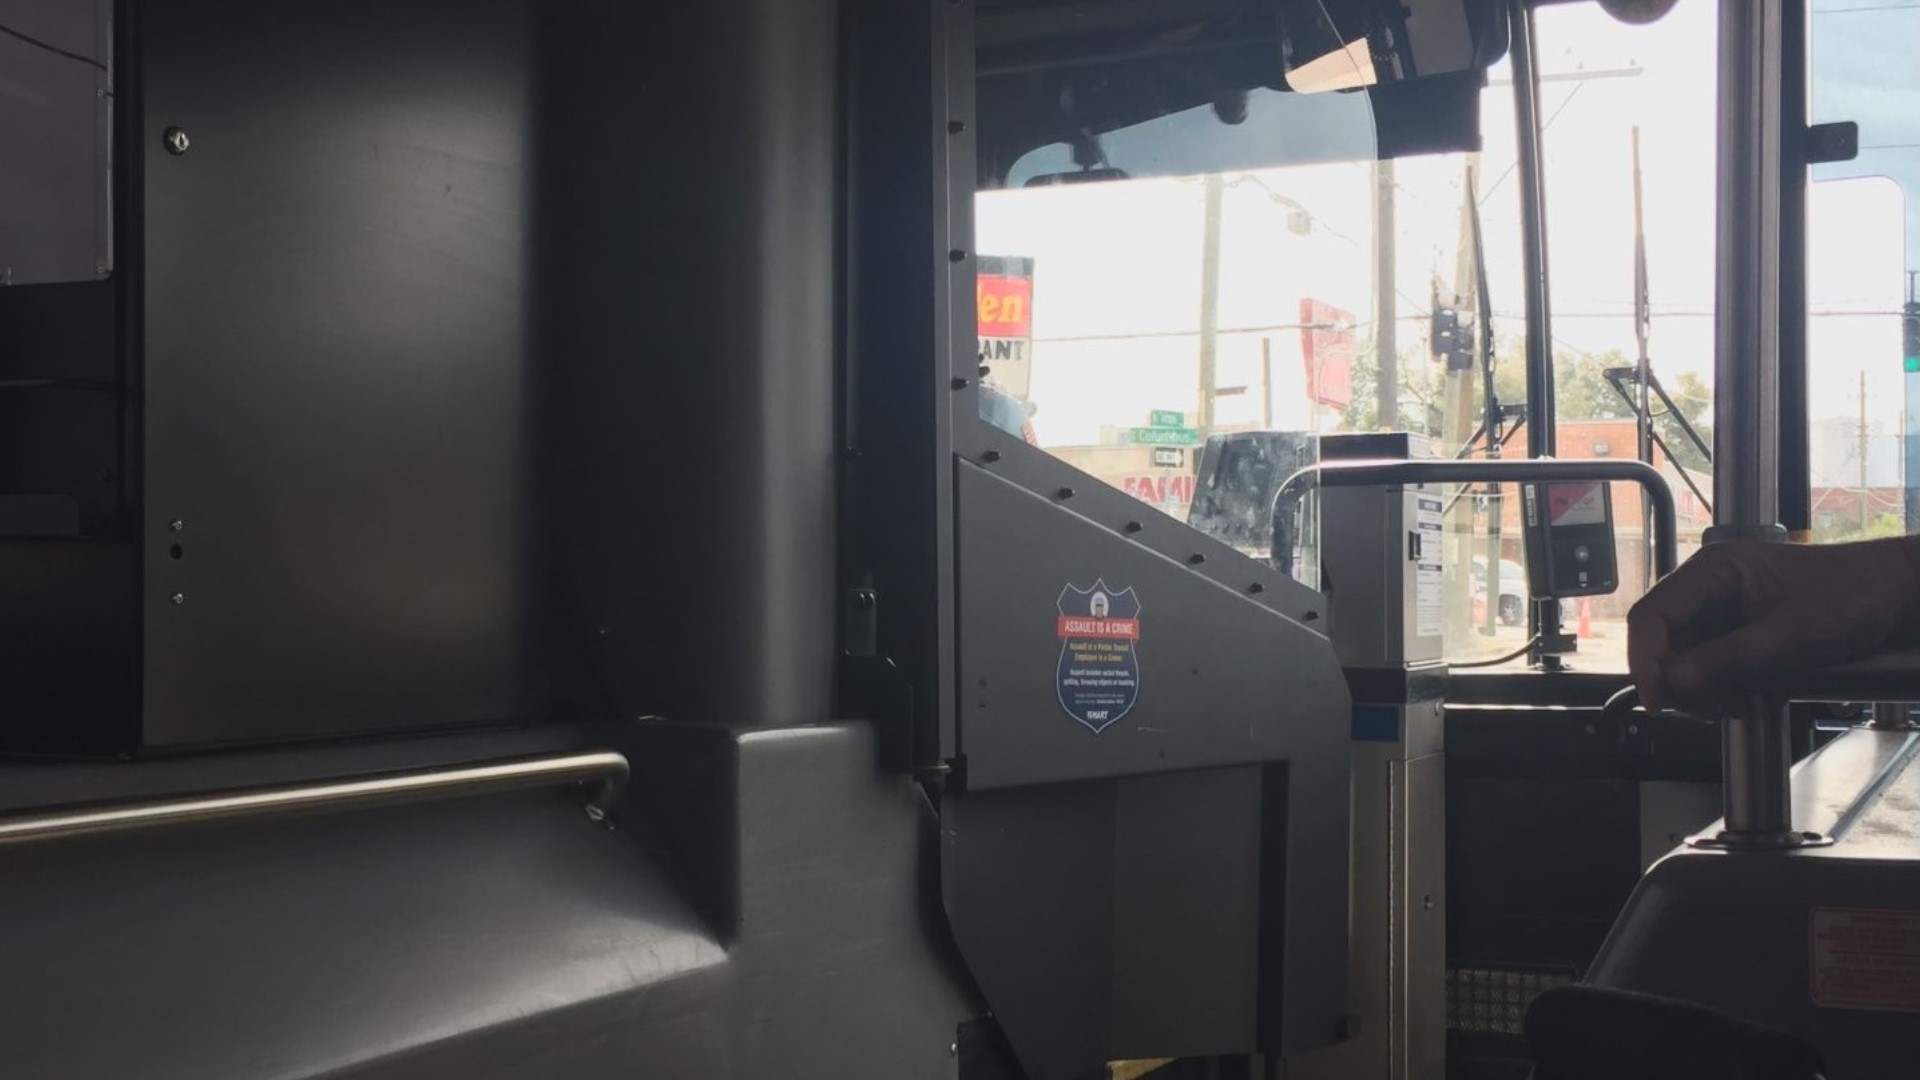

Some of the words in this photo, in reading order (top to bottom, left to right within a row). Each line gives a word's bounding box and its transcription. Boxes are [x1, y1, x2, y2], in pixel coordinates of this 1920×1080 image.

[977, 281, 1024, 323] en
[977, 340, 1024, 361] ANT
[1124, 476, 1196, 503] FAMI
[1064, 620, 1096, 633] ASSAULT
[1096, 621, 1104, 634] IS
[1105, 622, 1111, 634] A
[1111, 622, 1134, 635] CRIME
